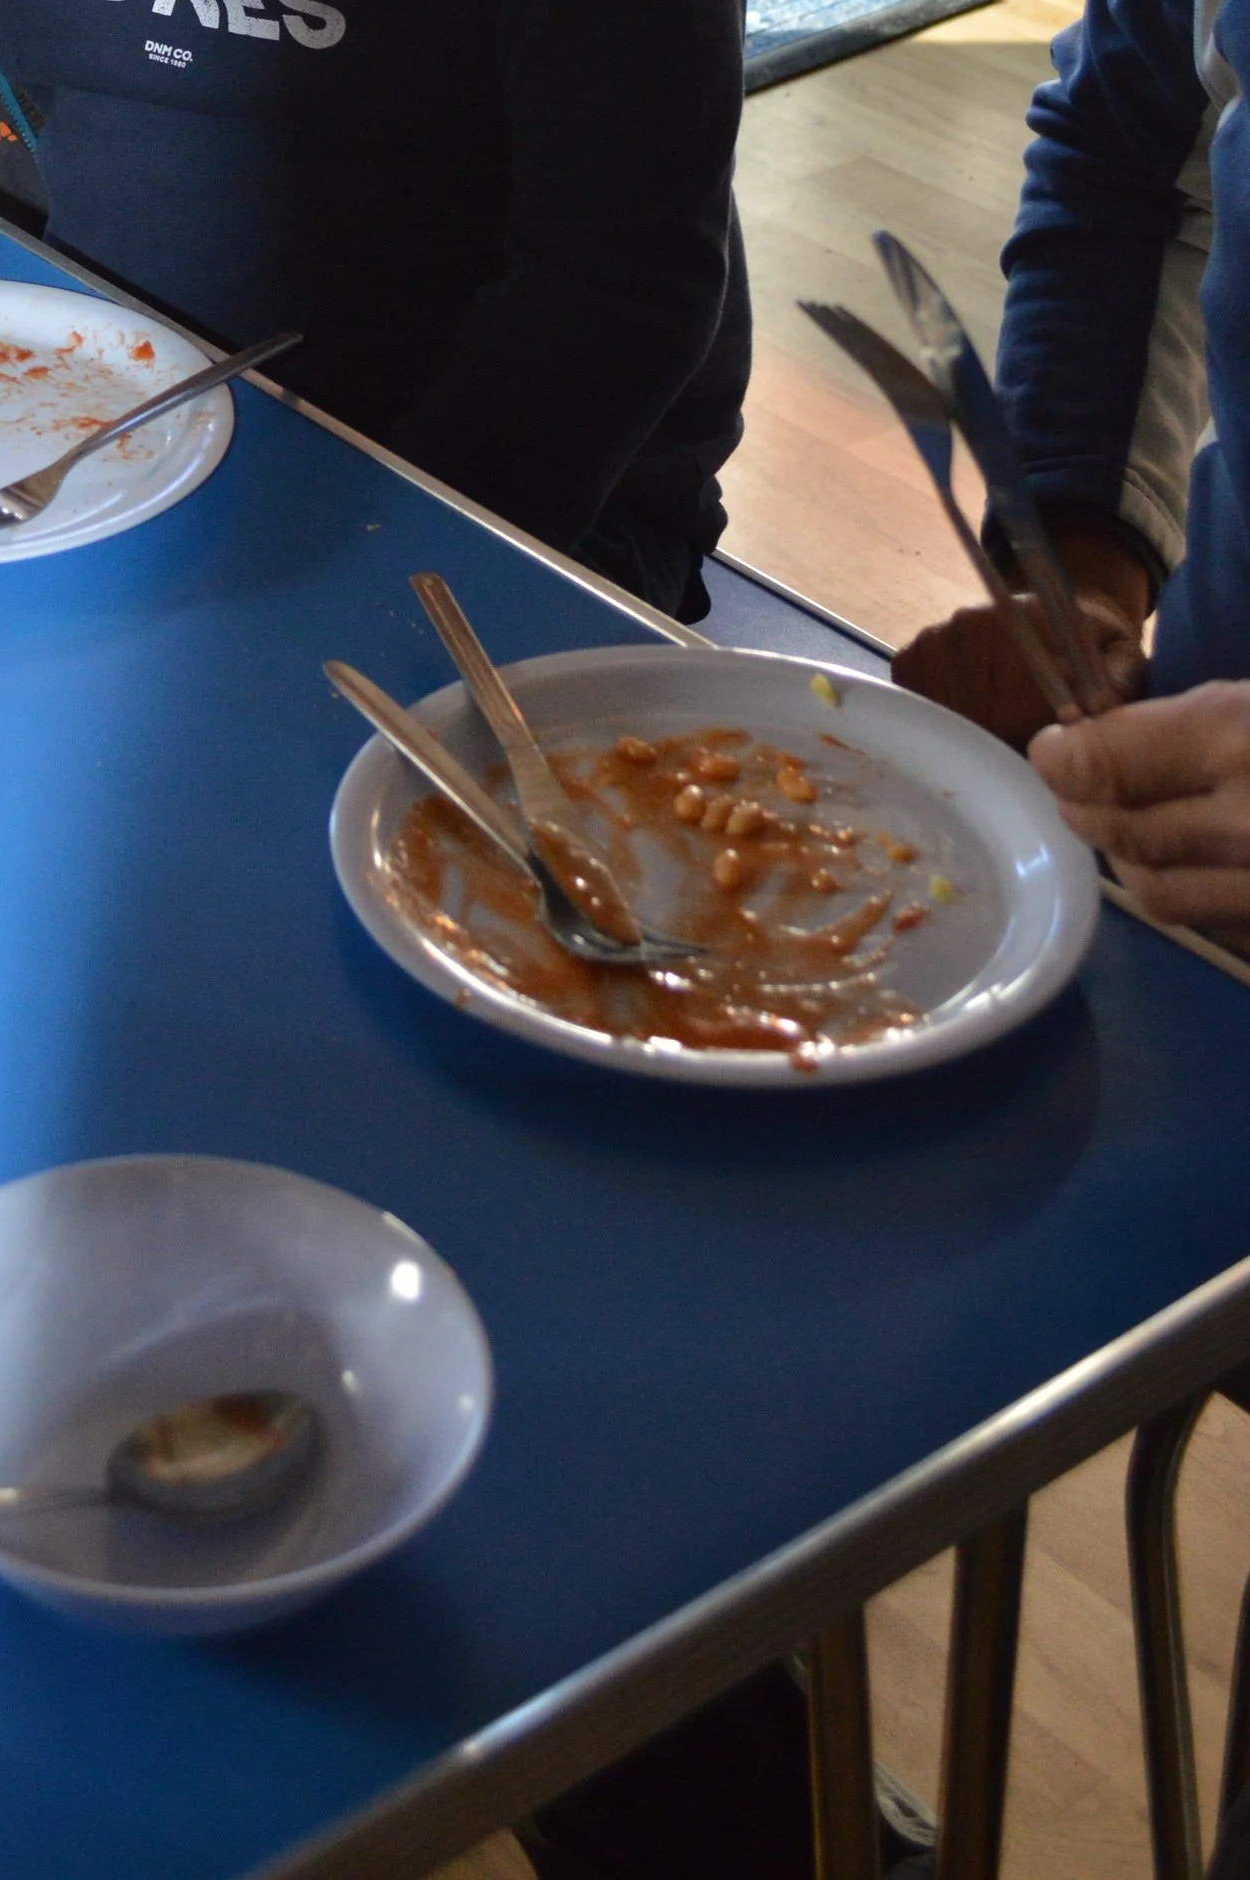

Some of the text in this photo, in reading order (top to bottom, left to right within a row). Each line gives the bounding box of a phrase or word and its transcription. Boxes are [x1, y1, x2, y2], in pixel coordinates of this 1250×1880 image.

[145, 40, 193, 62] DNM CO.
[148, 53, 169, 64] SINCE
